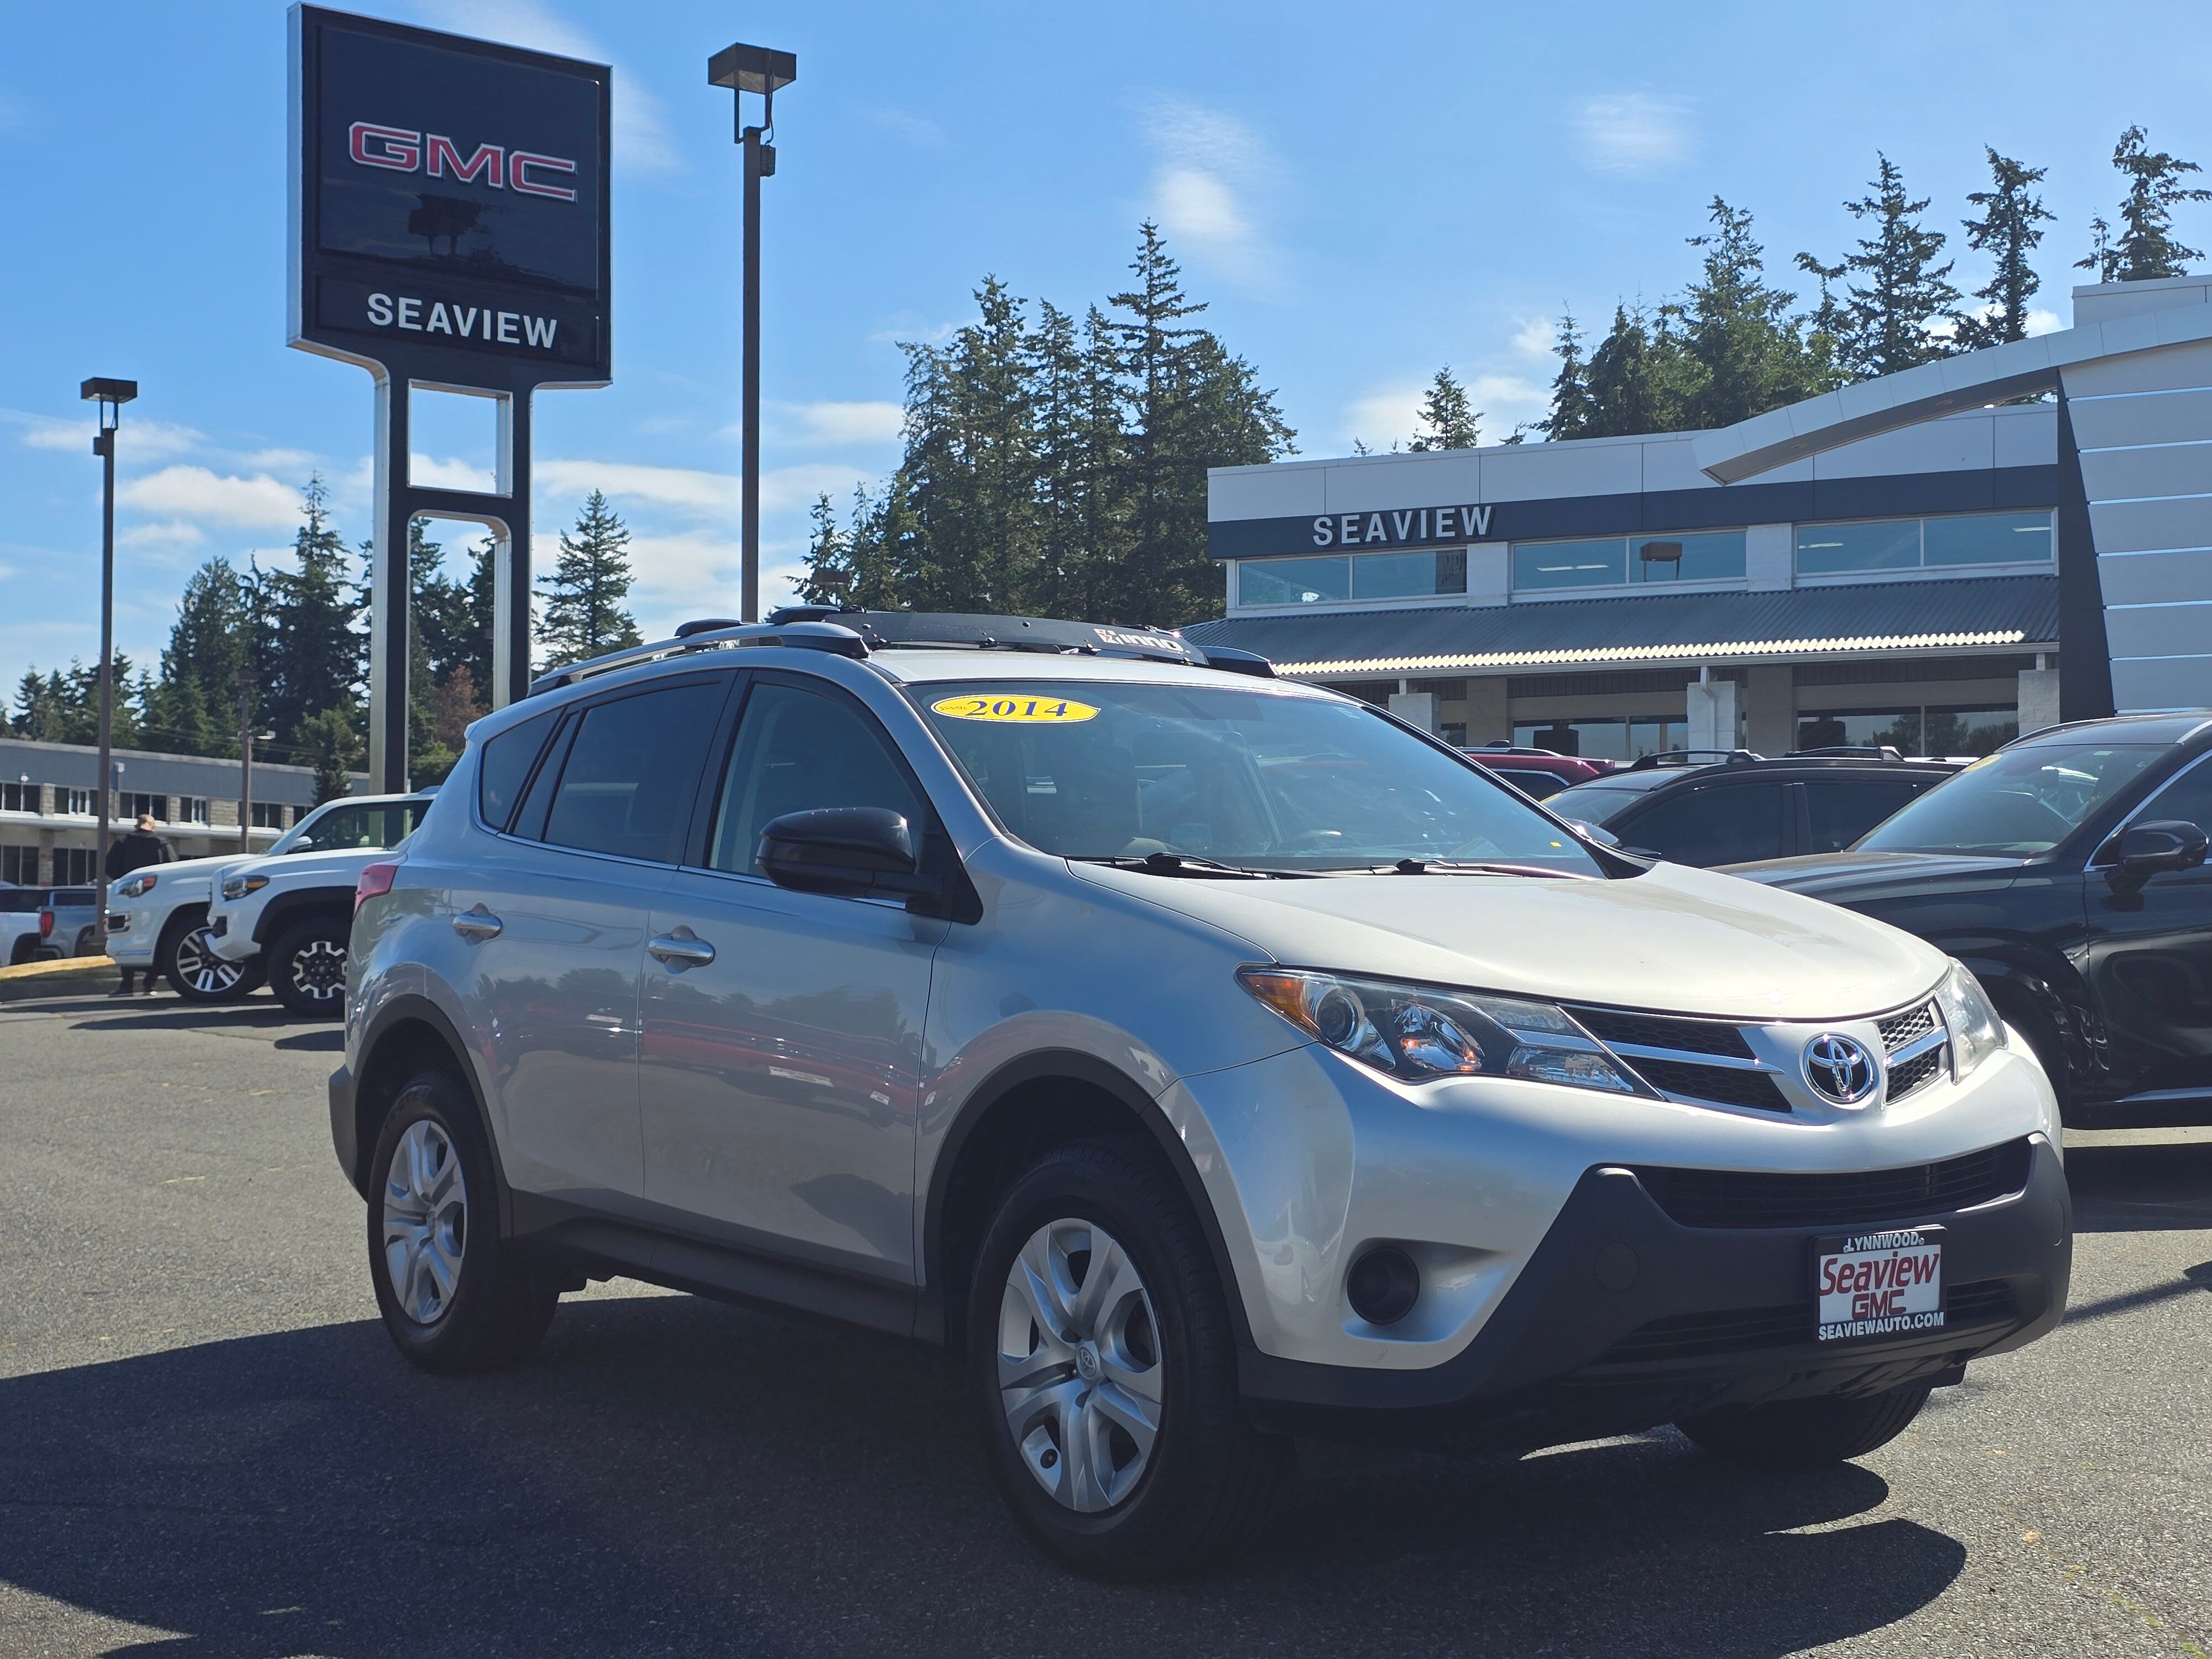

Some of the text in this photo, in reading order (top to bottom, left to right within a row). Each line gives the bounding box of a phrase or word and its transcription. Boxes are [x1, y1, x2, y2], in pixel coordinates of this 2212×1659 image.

[348, 121, 577, 203] GMC
[367, 293, 557, 349] SEAVIEW
[1313, 505, 1492, 546] SEAVIEW
[964, 700, 1068, 717] 2014
[1847, 1232, 1919, 1252] LYNNWOOD
[1819, 1251, 1939, 1296] Seaview
[1851, 1288, 1906, 1320] GMC
[1818, 1312, 1944, 1340] SEAVIEWAUTO.COM
